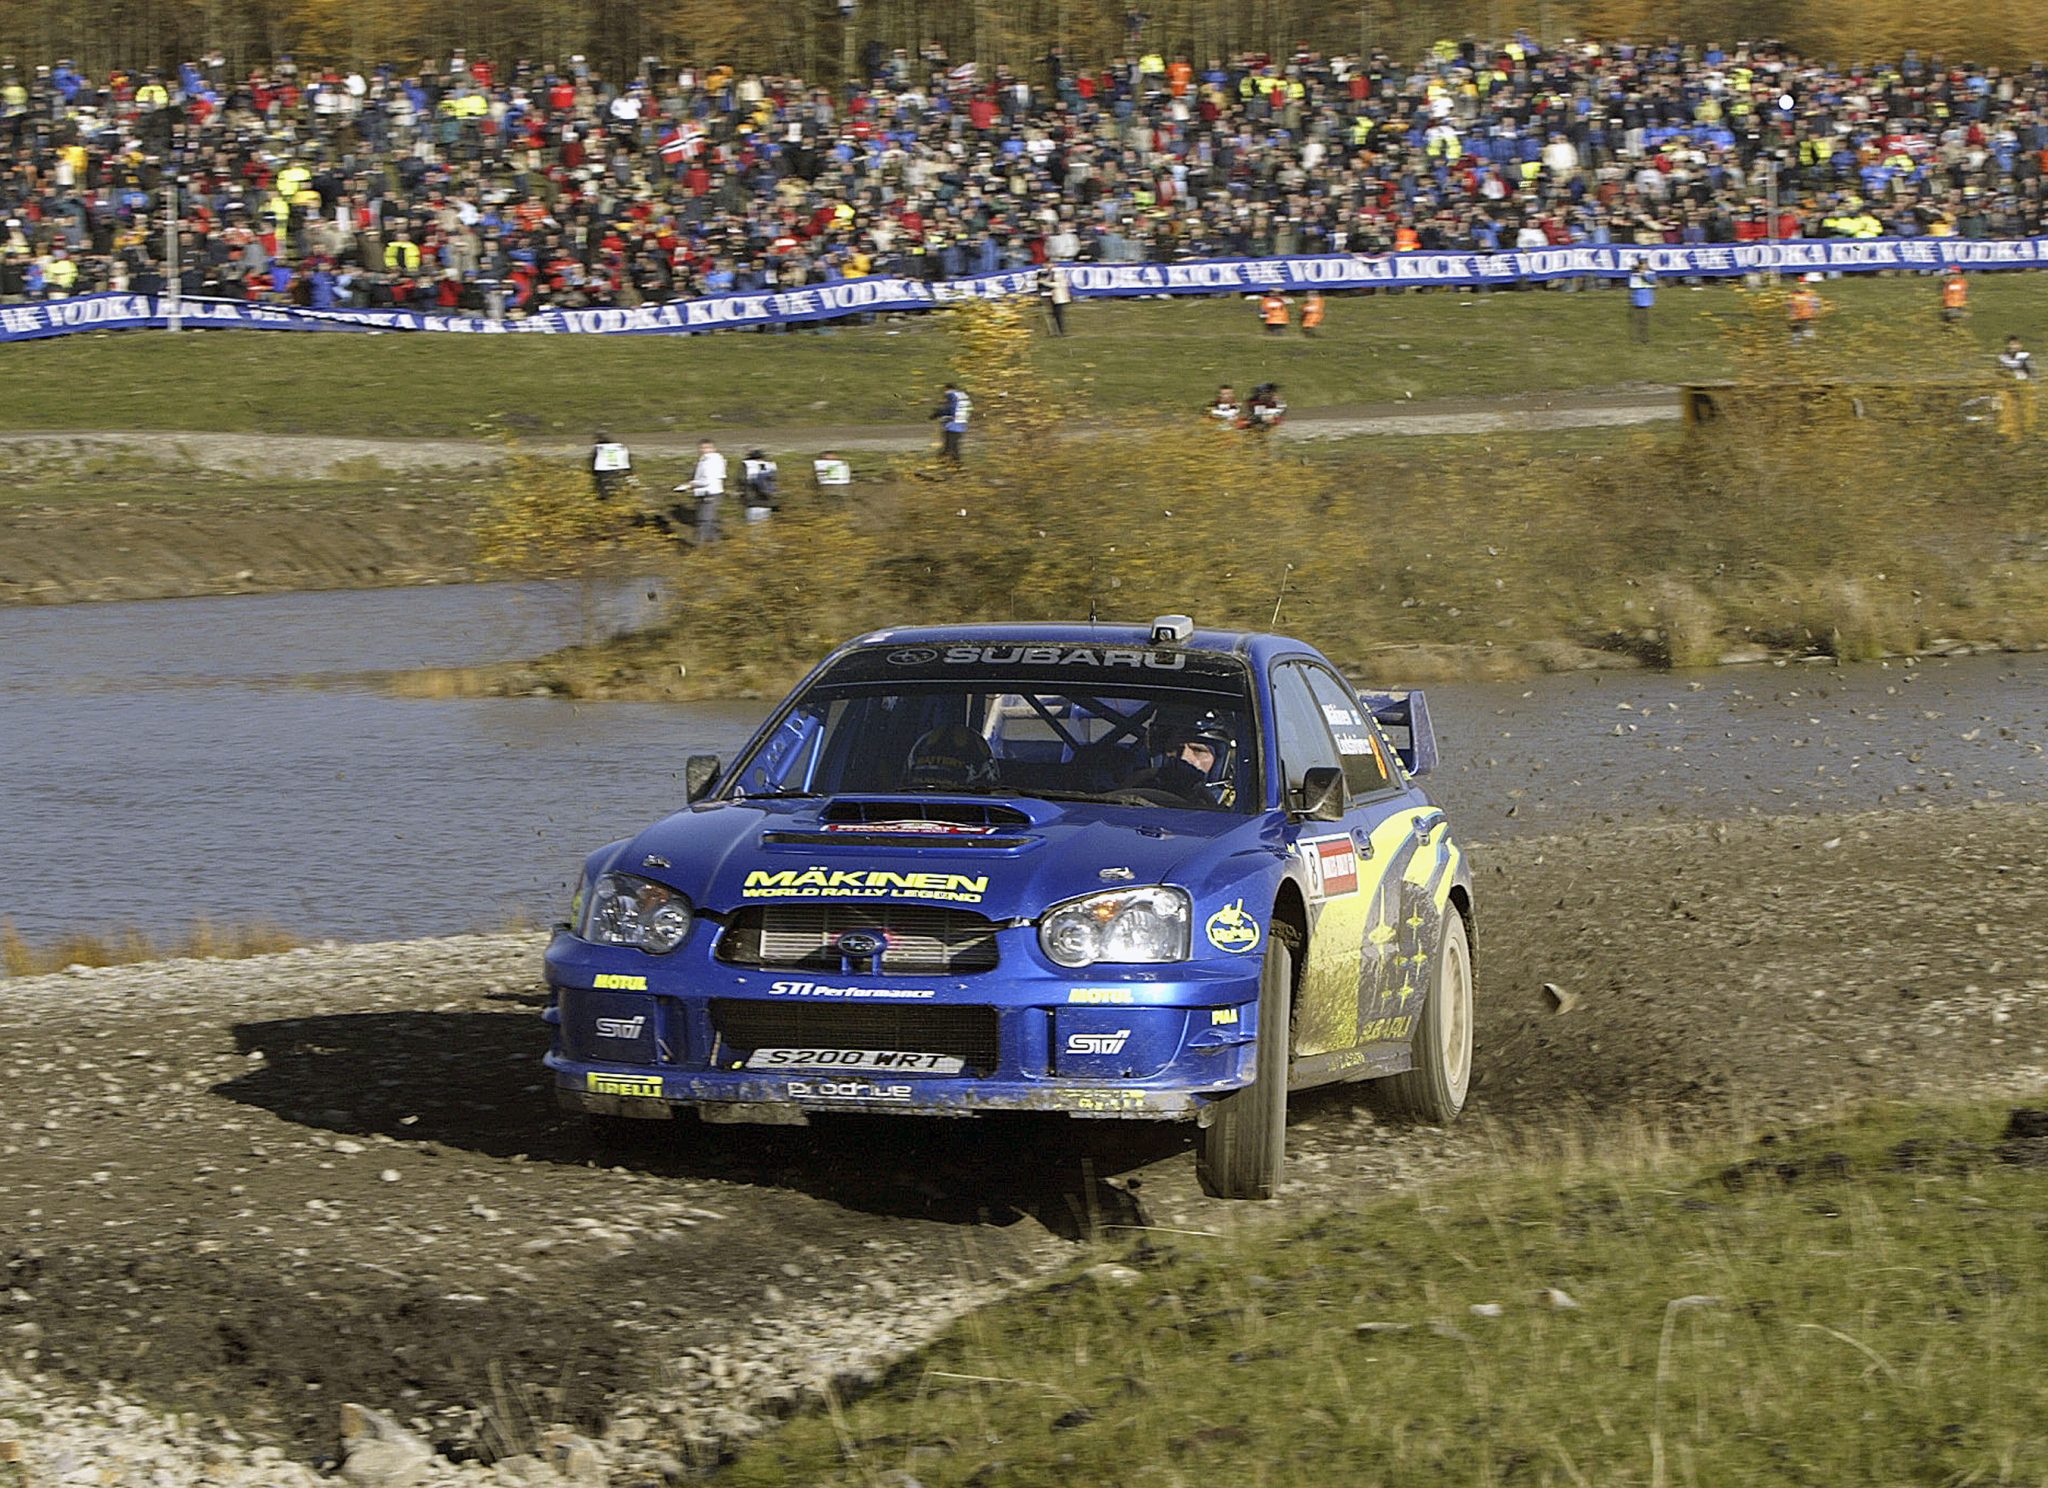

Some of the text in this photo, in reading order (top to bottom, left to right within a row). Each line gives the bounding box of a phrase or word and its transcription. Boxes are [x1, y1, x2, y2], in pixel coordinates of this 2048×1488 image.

[562, 305, 682, 333] VODKA
[686, 297, 771, 325] KICK
[821, 279, 932, 309] VODKA
[1165, 265, 1244, 287] KICK
[1394, 256, 1473, 280] KICK
[1516, 249, 1616, 275] VODKA
[1939, 240, 2036, 262] VODKA
[943, 647, 1186, 671] SUBARU
[744, 867, 989, 892] MÄKINEN
[743, 888, 981, 903] WORLD RALLY LEGEND
[813, 985, 935, 998] Performance
[768, 1050, 947, 1068] S200 WRT
[587, 1072, 664, 1097] PIRELLI
